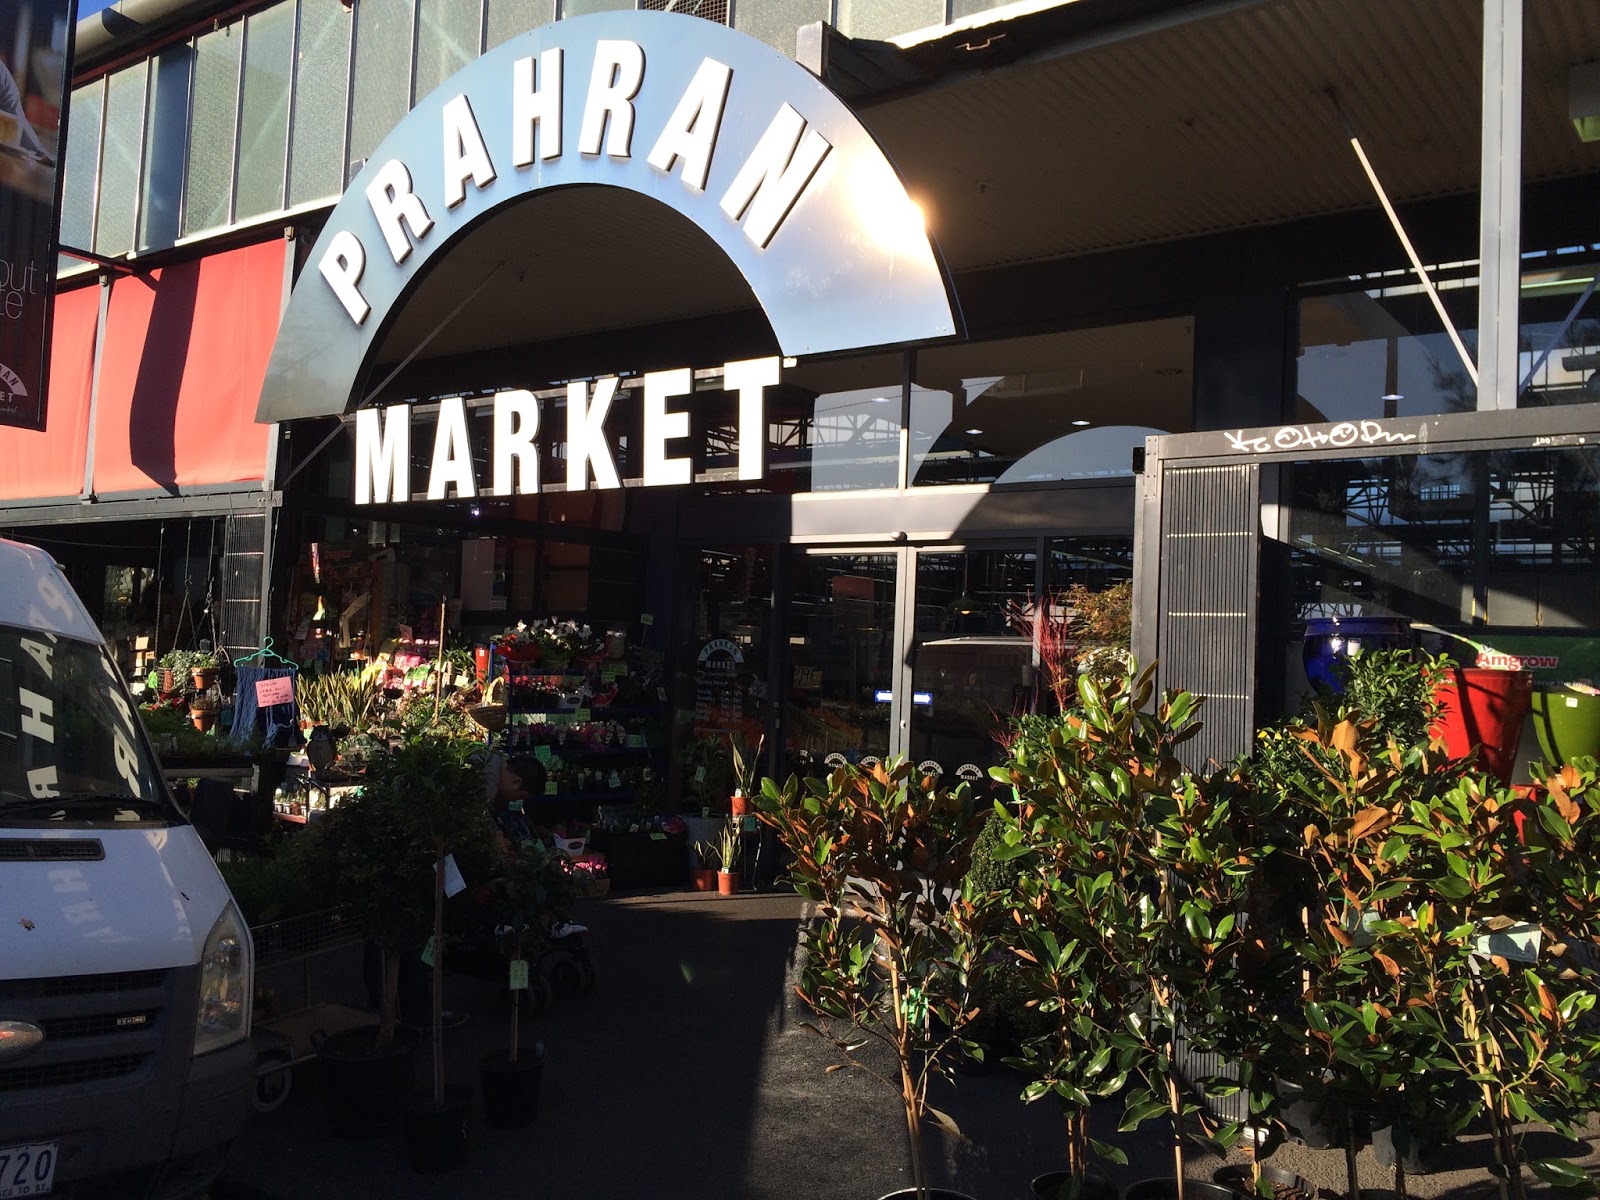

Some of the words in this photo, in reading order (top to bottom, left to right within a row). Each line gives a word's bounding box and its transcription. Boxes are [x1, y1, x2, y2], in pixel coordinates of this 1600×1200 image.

[318, 39, 834, 326] PRAHRAN
[355, 355, 782, 505] MARKET
[1476, 653, 1559, 671] Amgrow
[0, 1150, 52, 1185] 720
[0, 1188, 13, 1198] CE
[18, 1186, 30, 1194] TO
